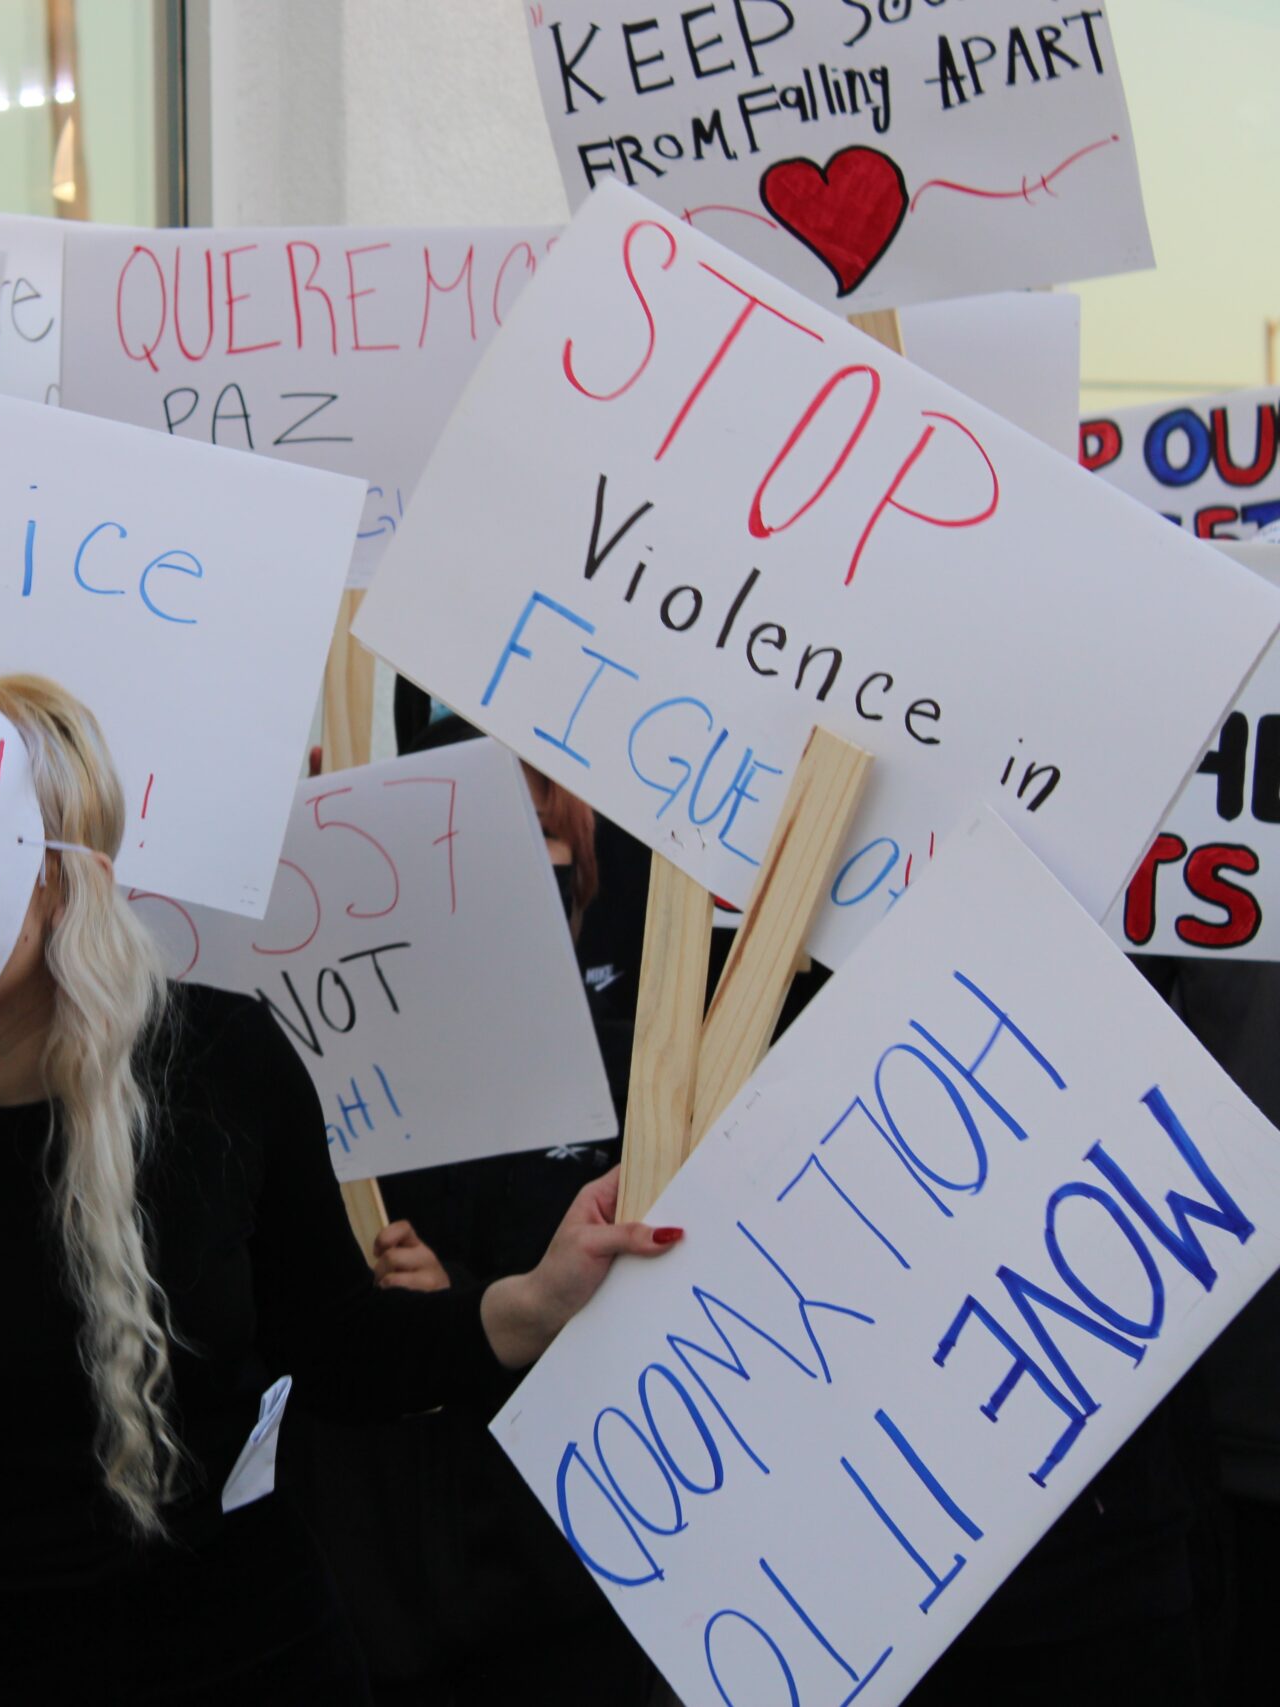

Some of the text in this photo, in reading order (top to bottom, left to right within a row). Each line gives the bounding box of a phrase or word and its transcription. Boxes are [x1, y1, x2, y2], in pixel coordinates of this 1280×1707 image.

[549, 0, 795, 115] KEEP
[576, 108, 738, 191] FROM
[736, 63, 891, 154] Falling
[924, 10, 1104, 110] APART
[116, 240, 558, 372] QUEREMO
[561, 219, 1000, 585] STOP
[163, 383, 354, 450] PAZ
[584, 472, 943, 746] Violence
[999, 738, 1062, 814] in
[556, 970, 1067, 1586] HOLLYWOOD
[933, 1084, 1256, 1488] MOVE
[839, 1409, 985, 1613] IT
